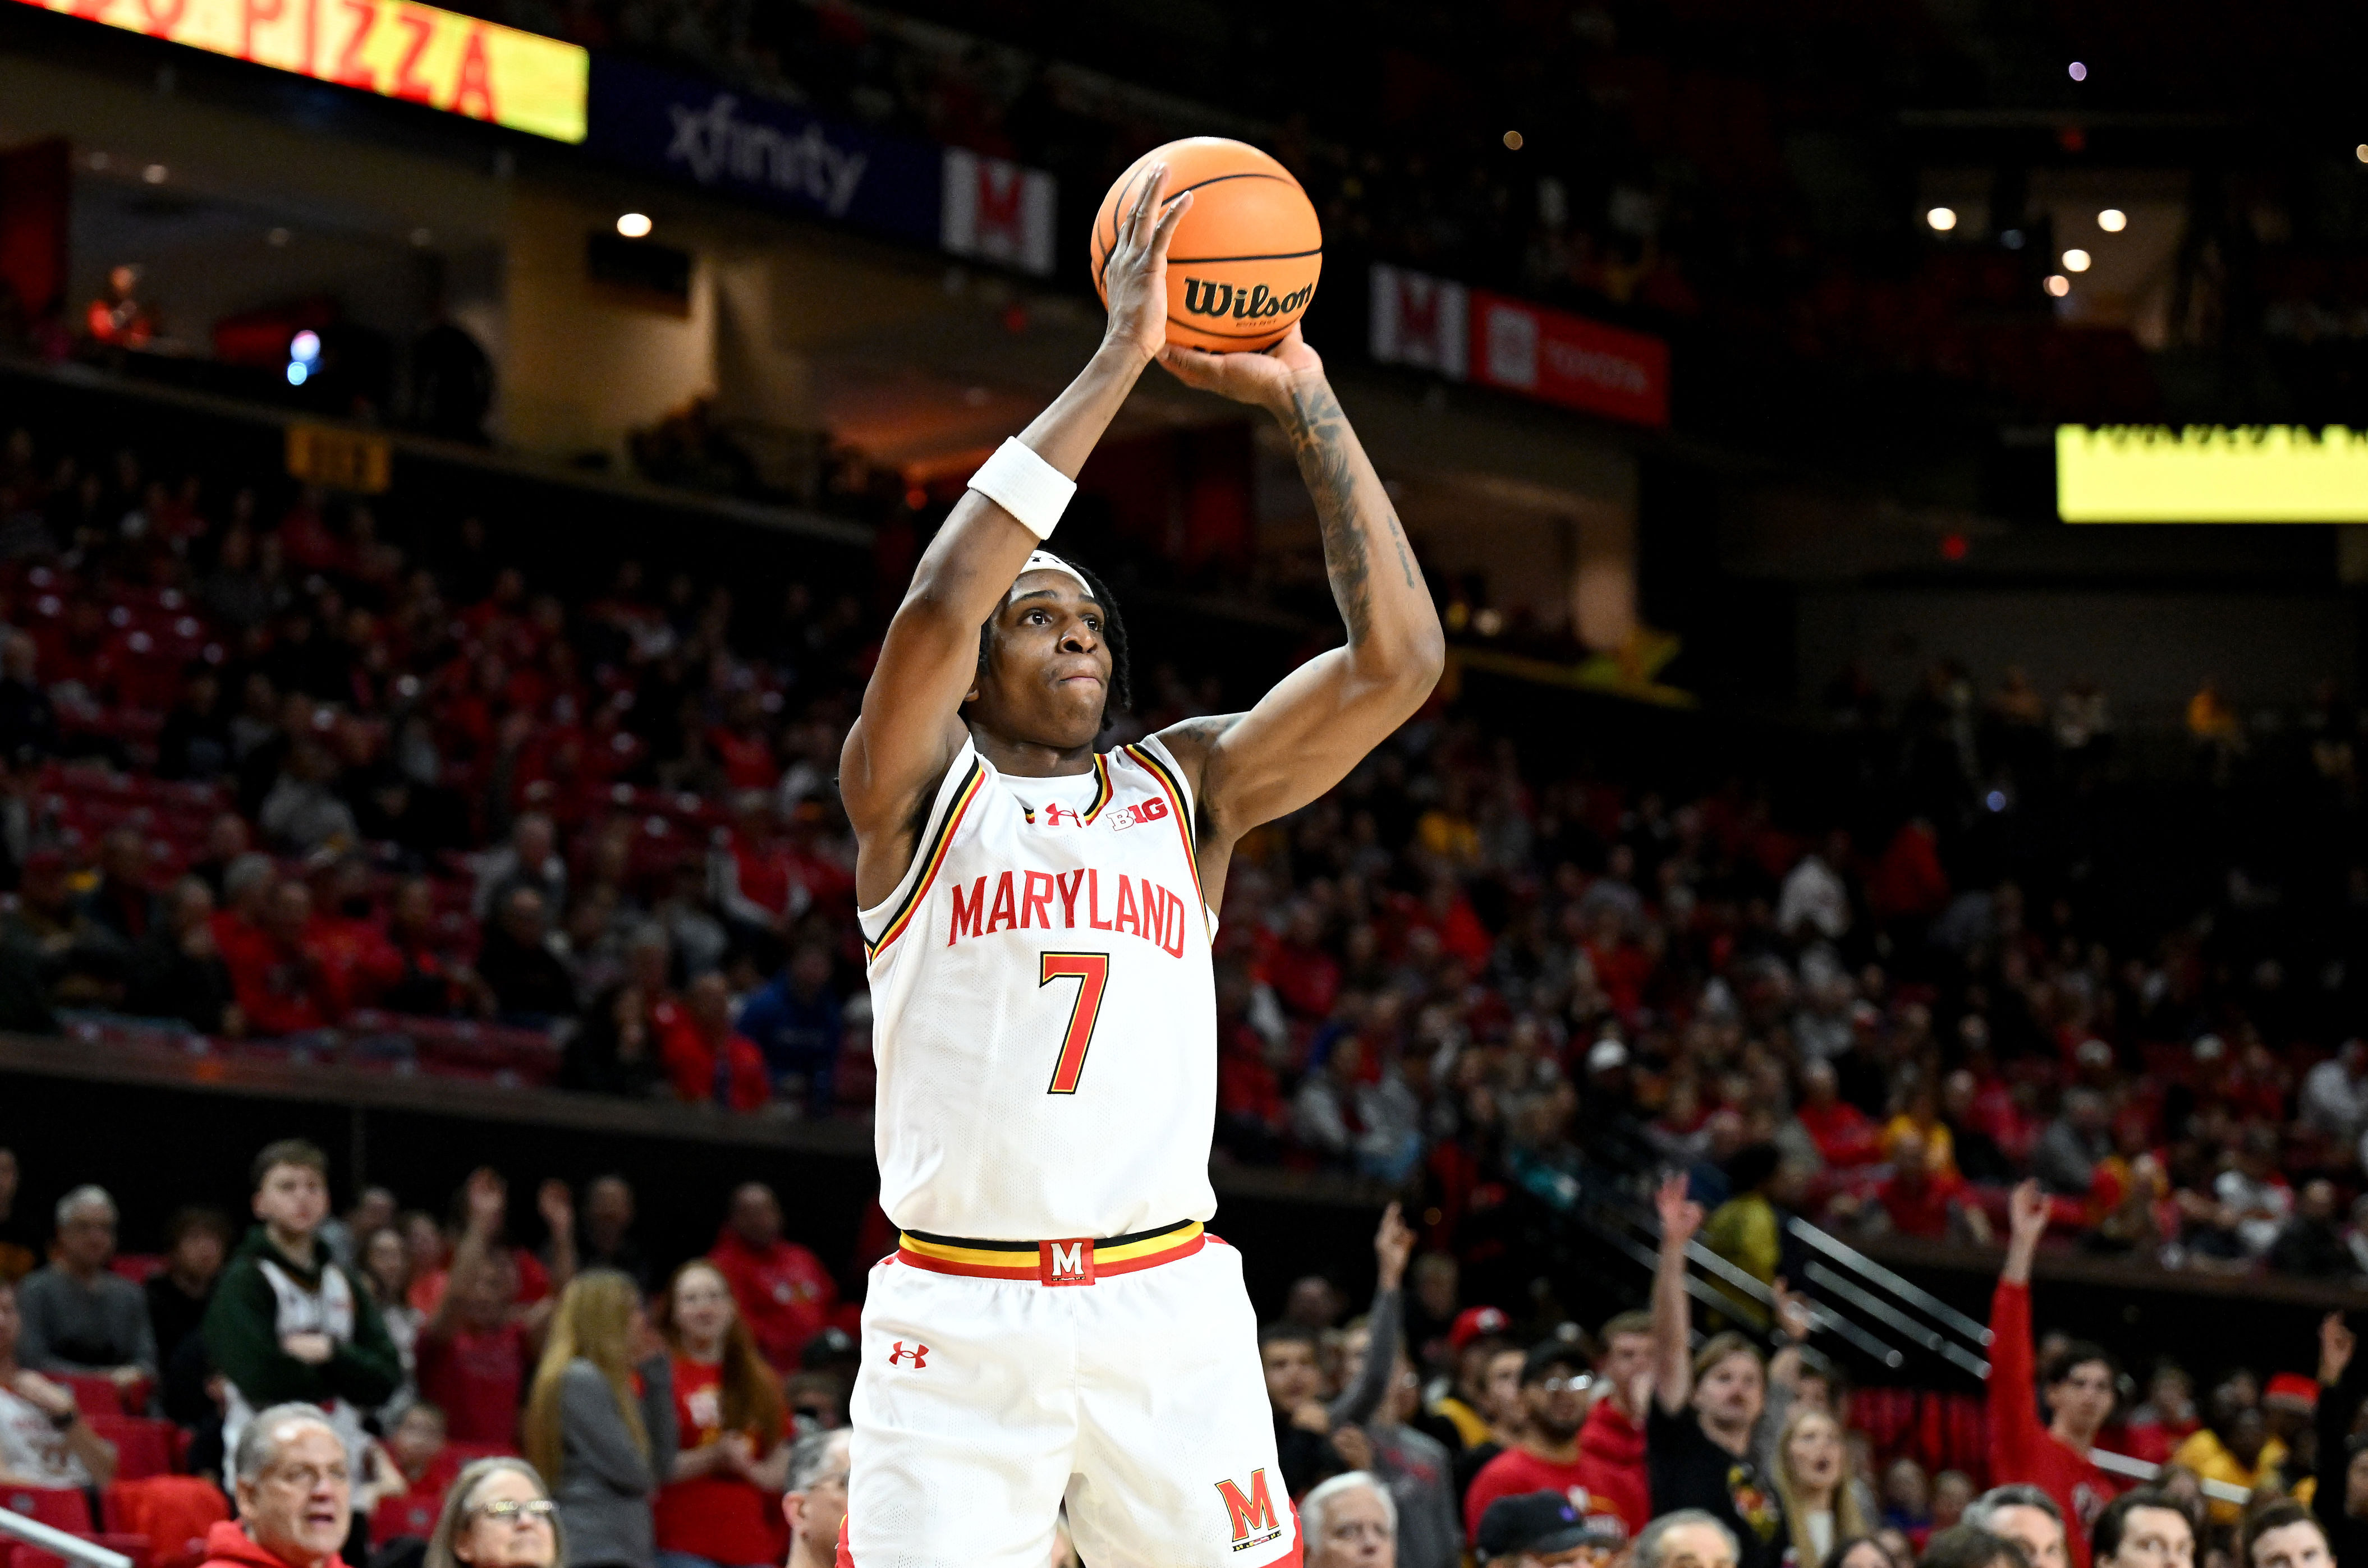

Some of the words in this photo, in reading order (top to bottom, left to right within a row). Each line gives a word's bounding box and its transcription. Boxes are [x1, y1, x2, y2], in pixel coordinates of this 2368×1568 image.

[1184, 276, 1313, 319] Wilson
[947, 868, 1185, 959] MARYLAND
[1039, 951, 1109, 1094] 7
[1050, 1241, 1085, 1277] M
[1214, 1468, 1279, 1543] M
